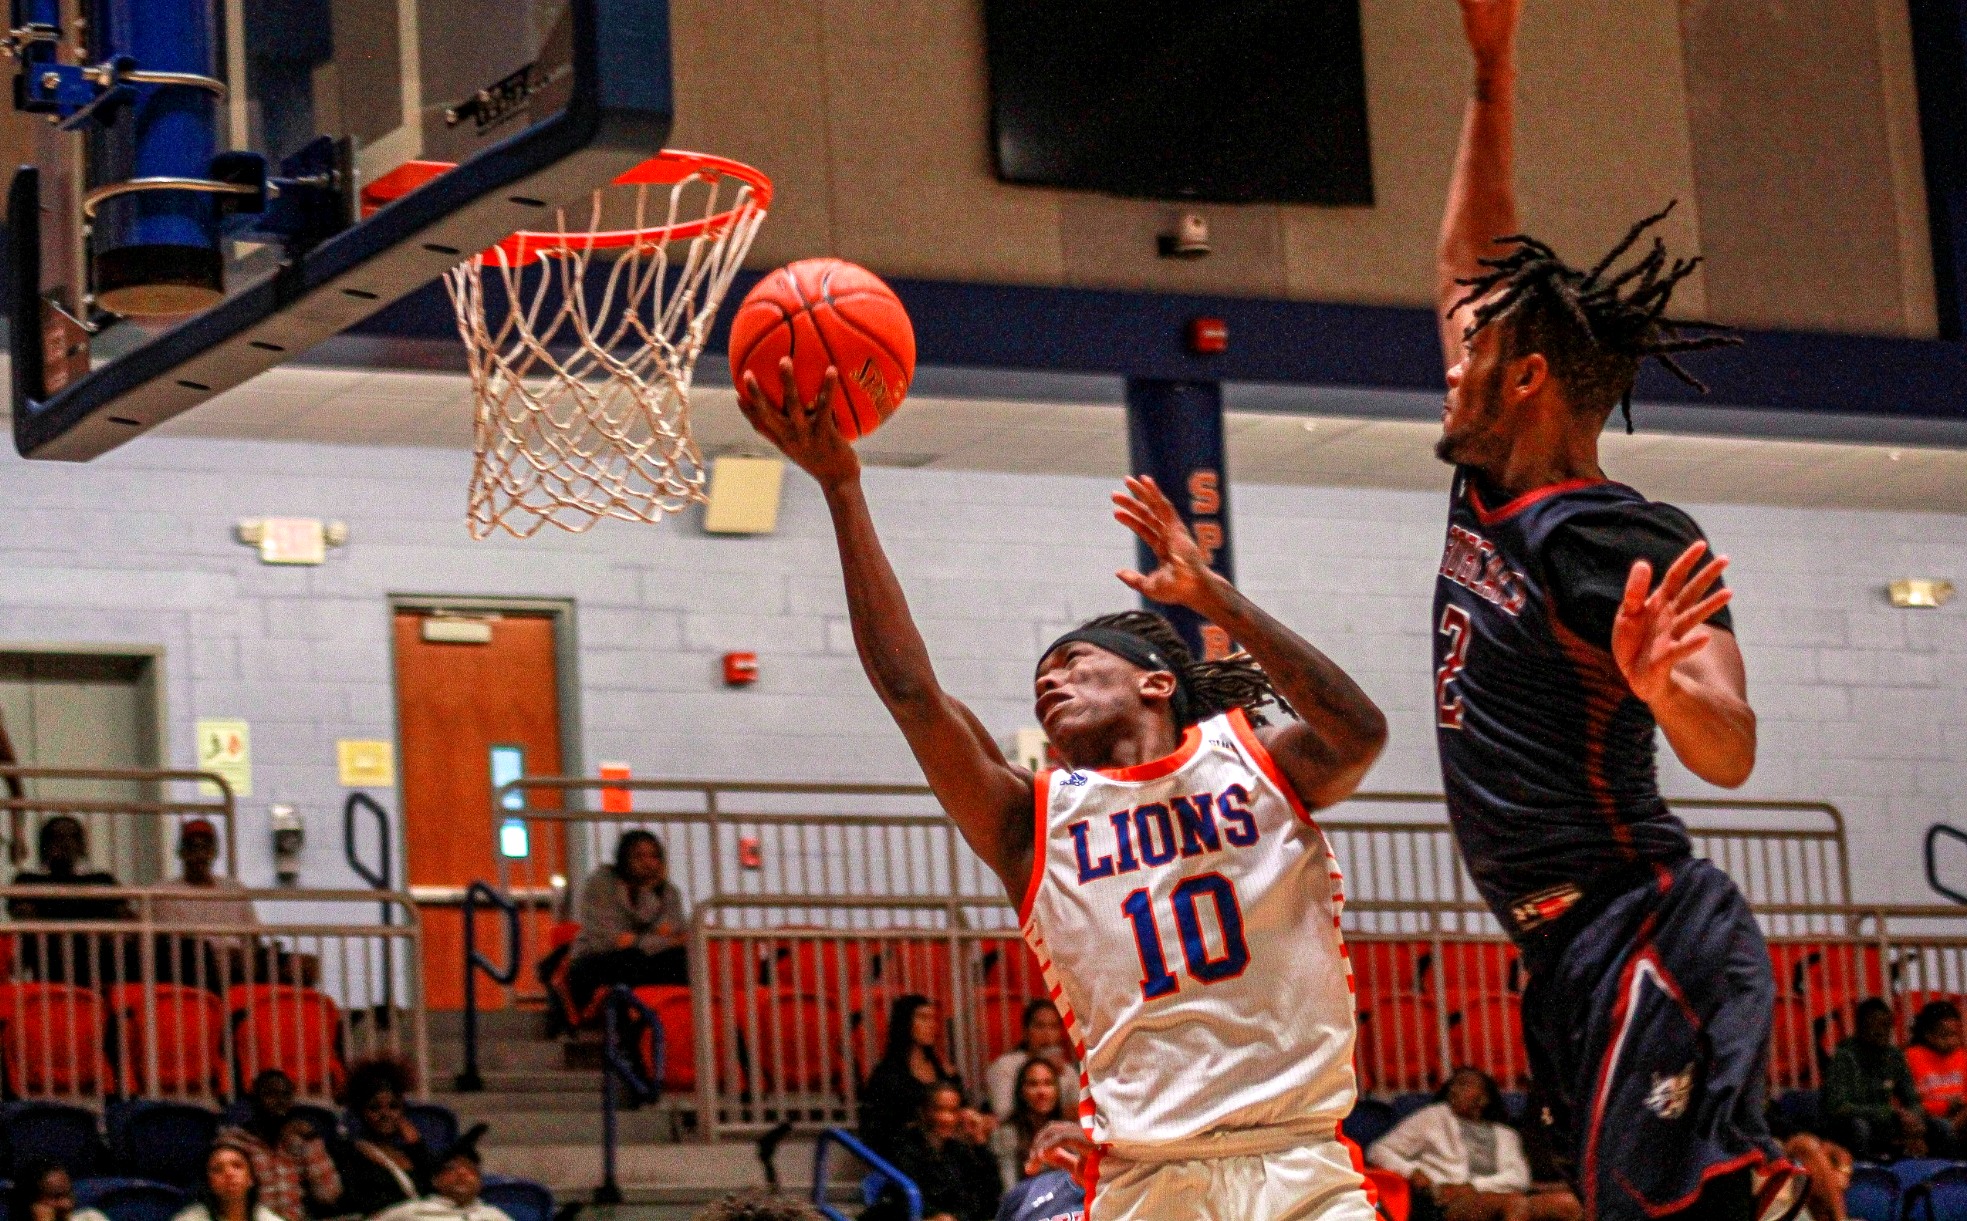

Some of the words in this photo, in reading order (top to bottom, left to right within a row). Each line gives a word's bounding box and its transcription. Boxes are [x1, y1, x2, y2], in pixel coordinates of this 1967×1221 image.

[1437, 602, 1471, 729] 2
[1067, 783, 1260, 886] LIONS
[1120, 870, 1251, 1003] 10
